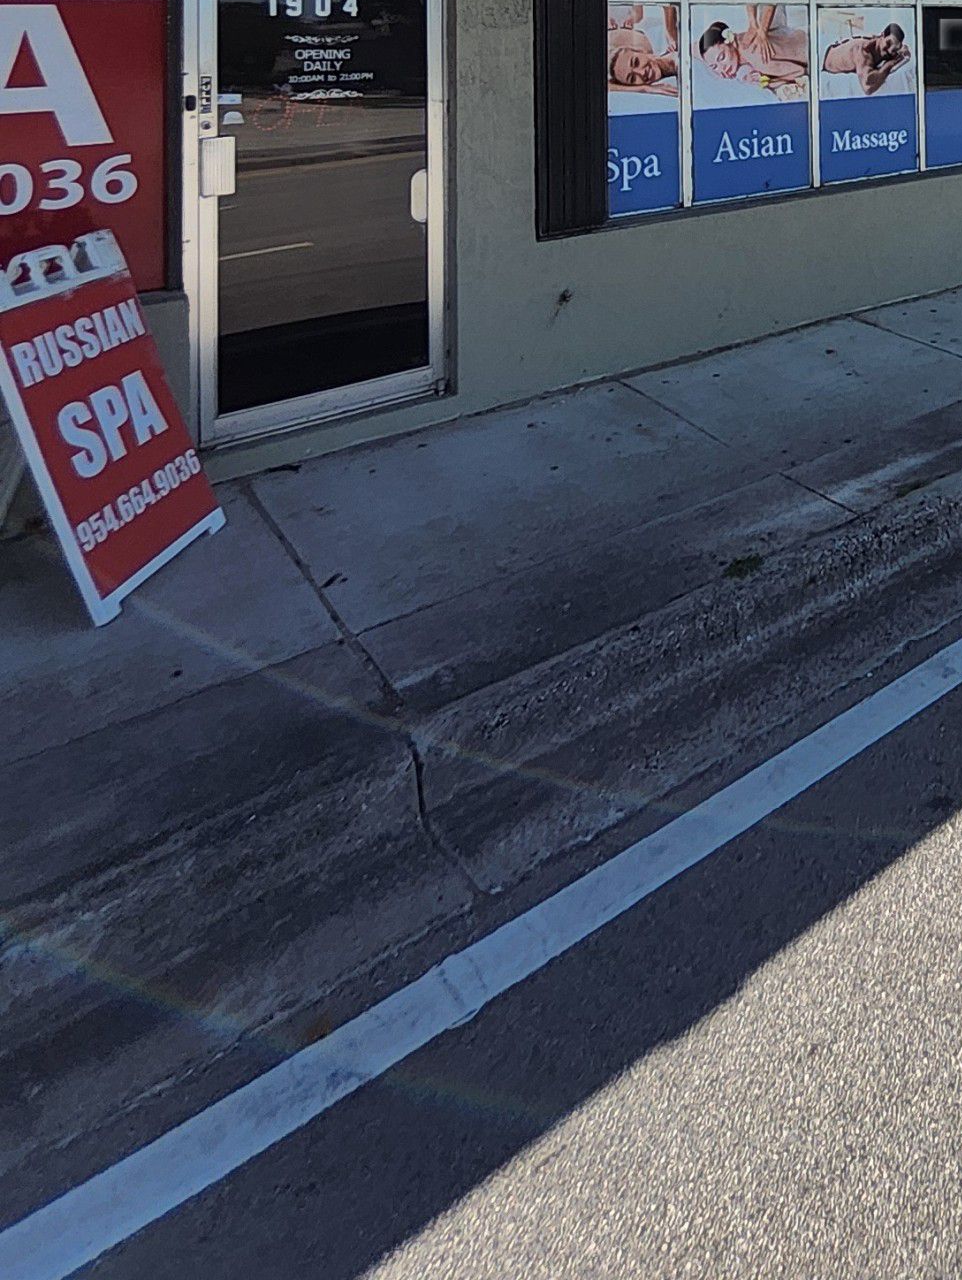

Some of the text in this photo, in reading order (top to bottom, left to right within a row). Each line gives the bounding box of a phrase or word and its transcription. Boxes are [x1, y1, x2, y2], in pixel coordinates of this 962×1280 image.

[294, 48, 351, 60] OPENING
[303, 60, 344, 72] DAILY
[606, 125, 908, 192] Spa Asian Massage
[11, 297, 147, 390] RUSSIAN
[57, 369, 170, 480] SPA
[75, 447, 201, 554] 954.664.9036
